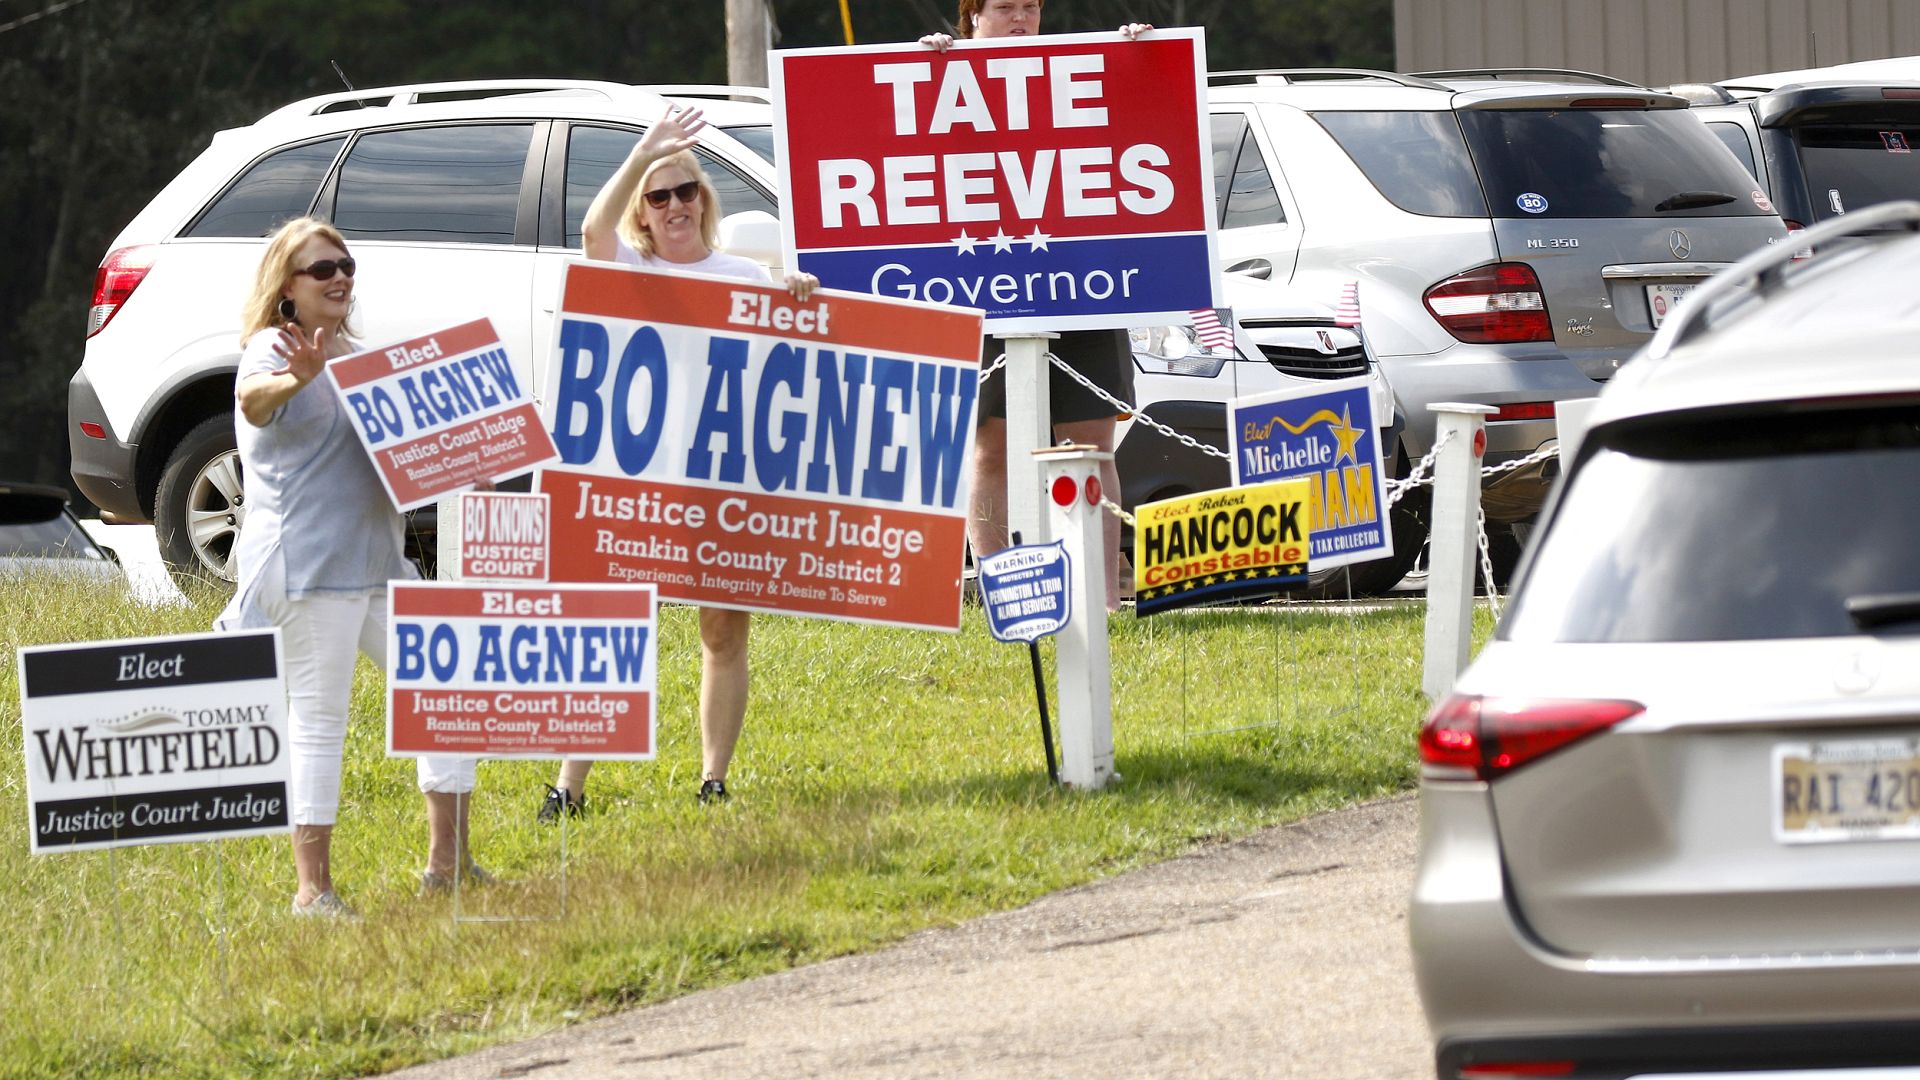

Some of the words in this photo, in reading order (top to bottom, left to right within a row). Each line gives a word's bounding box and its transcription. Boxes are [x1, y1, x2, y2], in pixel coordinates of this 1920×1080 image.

[874, 54, 1109, 136] TATE
[817, 143, 1175, 229] REEVES
[1524, 199, 1541, 208] BO
[1527, 239, 1547, 249] ML
[1550, 238, 1579, 249] 350
[871, 263, 1139, 306] Governor
[728, 290, 830, 335] Elect
[385, 338, 444, 370] Elect
[347, 386, 404, 445] BO
[398, 348, 521, 430] AGNEW
[553, 319, 669, 476] BO
[685, 336, 979, 509] AGNEW
[387, 440, 440, 469] Justice
[439, 425, 484, 453] Court
[481, 414, 527, 442] Judge
[1244, 418, 1271, 443] Elect
[406, 462, 444, 481] Rankin
[442, 451, 480, 470] County
[480, 438, 519, 457] District
[517, 434, 527, 446] 2
[1244, 436, 1332, 477] Michelle
[464, 497, 487, 543] BO
[489, 497, 545, 545] KNOWS
[575, 481, 706, 528] Justice
[717, 498, 818, 542] Court
[826, 510, 924, 559] Judge
[1153, 503, 1191, 521] Elect
[1198, 494, 1246, 512] Robert
[464, 545, 544, 561] JUSTICE
[1145, 502, 1302, 568] HANCOCK
[1316, 537, 1333, 554] TAX
[1334, 530, 1380, 550] COLLECTOR
[470, 561, 537, 576] COURT
[595, 529, 689, 562] Rankin
[696, 541, 787, 578] County
[798, 552, 885, 585] District
[887, 563, 901, 587] 2
[994, 553, 1044, 571] WARNING
[998, 570, 1035, 584] PROTECTED
[1034, 568, 1044, 577] BY
[1145, 545, 1302, 586] Constable
[481, 591, 563, 615] Elect
[607, 562, 697, 588] Experience,
[700, 572, 764, 597] Integrity
[767, 580, 779, 595] &
[781, 582, 827, 601] Desire
[829, 587, 845, 602] To
[847, 588, 887, 607] Serve
[1041, 577, 1062, 595] TRIM
[998, 602, 1022, 620] ALARM
[1021, 594, 1057, 616] SERVICES
[117, 653, 185, 681] Elect
[396, 623, 459, 683] BO
[473, 624, 649, 685] AGNEW
[183, 704, 269, 728] TOMMY
[413, 692, 489, 714] Justice
[494, 693, 558, 714] Court
[563, 694, 629, 718] Judge
[426, 716, 481, 732] Rankin
[484, 717, 540, 735] County
[548, 718, 604, 733] District
[607, 718, 616, 733] 2
[33, 725, 280, 783] WHITFIELD
[40, 806, 125, 835] Justice
[131, 802, 202, 827] Court
[205, 793, 281, 822] Judge
[1784, 773, 1842, 814] RAI
